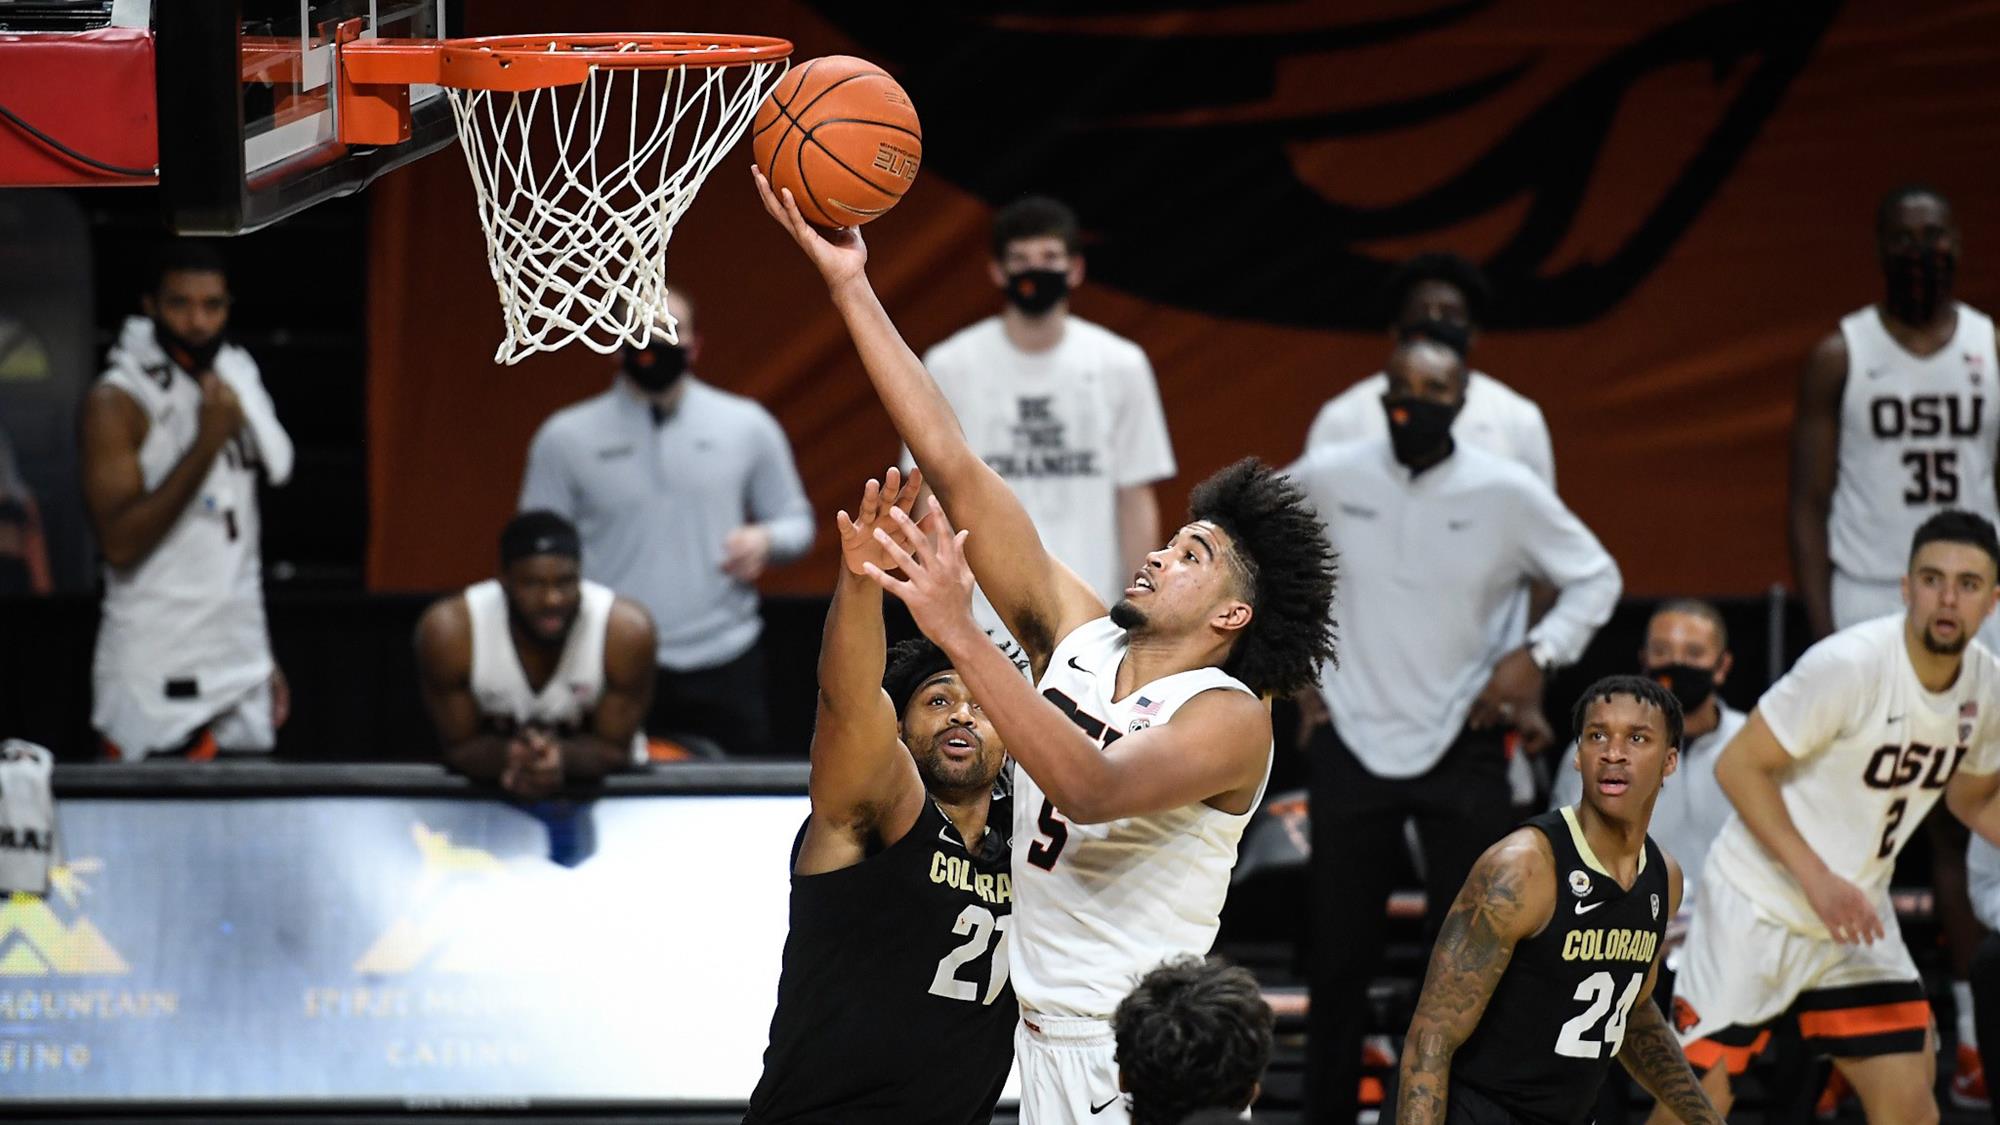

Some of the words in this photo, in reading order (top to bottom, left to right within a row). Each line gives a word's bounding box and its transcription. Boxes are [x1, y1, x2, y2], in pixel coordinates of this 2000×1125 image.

[873, 148, 917, 181] ELITE
[1871, 394, 1983, 439] OSU
[1903, 450, 1960, 505] 35
[1863, 741, 1968, 790] OSU
[1027, 797, 1069, 873] 5
[1877, 797, 1908, 859] 2
[1562, 928, 1657, 963] COLORADO
[1554, 971, 1643, 1059] 24
